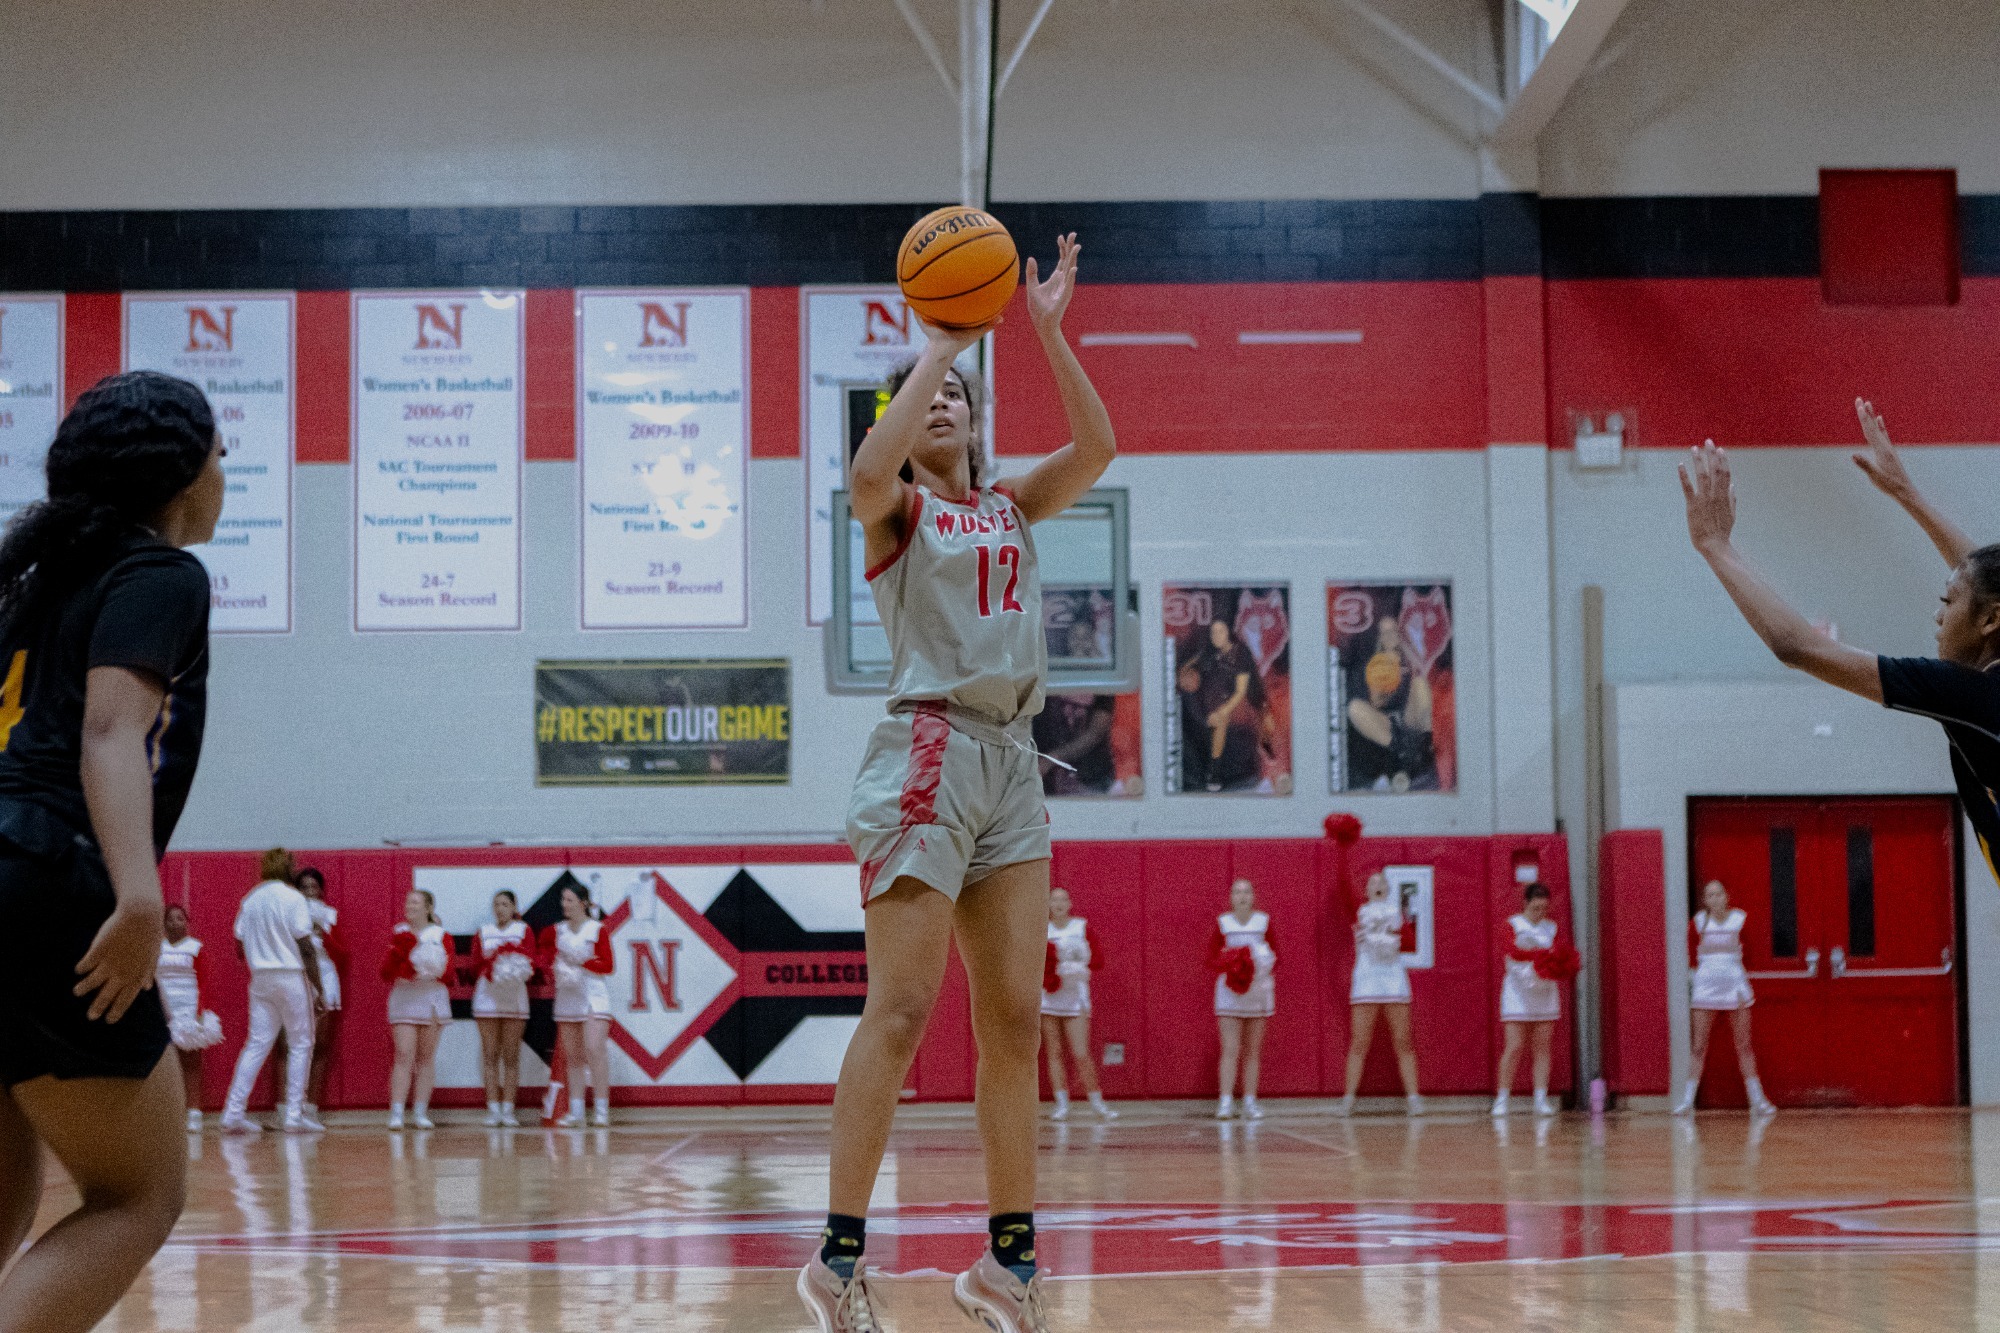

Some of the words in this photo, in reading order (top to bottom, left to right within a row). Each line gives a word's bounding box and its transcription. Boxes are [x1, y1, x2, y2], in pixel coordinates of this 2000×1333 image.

[912, 213, 991, 255] Wilson
[184, 305, 238, 352] N
[413, 303, 467, 349] N
[638, 302, 692, 347] N
[861, 301, 909, 346] N
[206, 378, 284, 394] Basketball
[363, 376, 431, 392] Women's
[436, 376, 513, 392] Basketball
[587, 389, 656, 404] Women's
[661, 388, 741, 404] Basketball
[403, 402, 474, 421] 2006-07
[628, 422, 700, 440] 2009-10
[407, 434, 452, 447] NCAA
[378, 461, 408, 474] SAC
[413, 461, 498, 474] Tournament
[399, 479, 478, 495] Champions
[590, 503, 650, 515] National
[363, 514, 424, 527] National
[429, 514, 513, 527] Tournament
[622, 520, 655, 533] First
[396, 531, 429, 544] First
[433, 531, 480, 544] Round
[421, 573, 455, 589] 24-7
[606, 581, 661, 595] Season
[666, 580, 723, 594] Record
[971, 543, 1027, 618] 12
[379, 592, 436, 606] Season
[440, 592, 497, 606] Record
[538, 703, 790, 743] #RESPECTOURGAME
[628, 938, 683, 1013] N
[765, 963, 869, 984] COLLEGE
